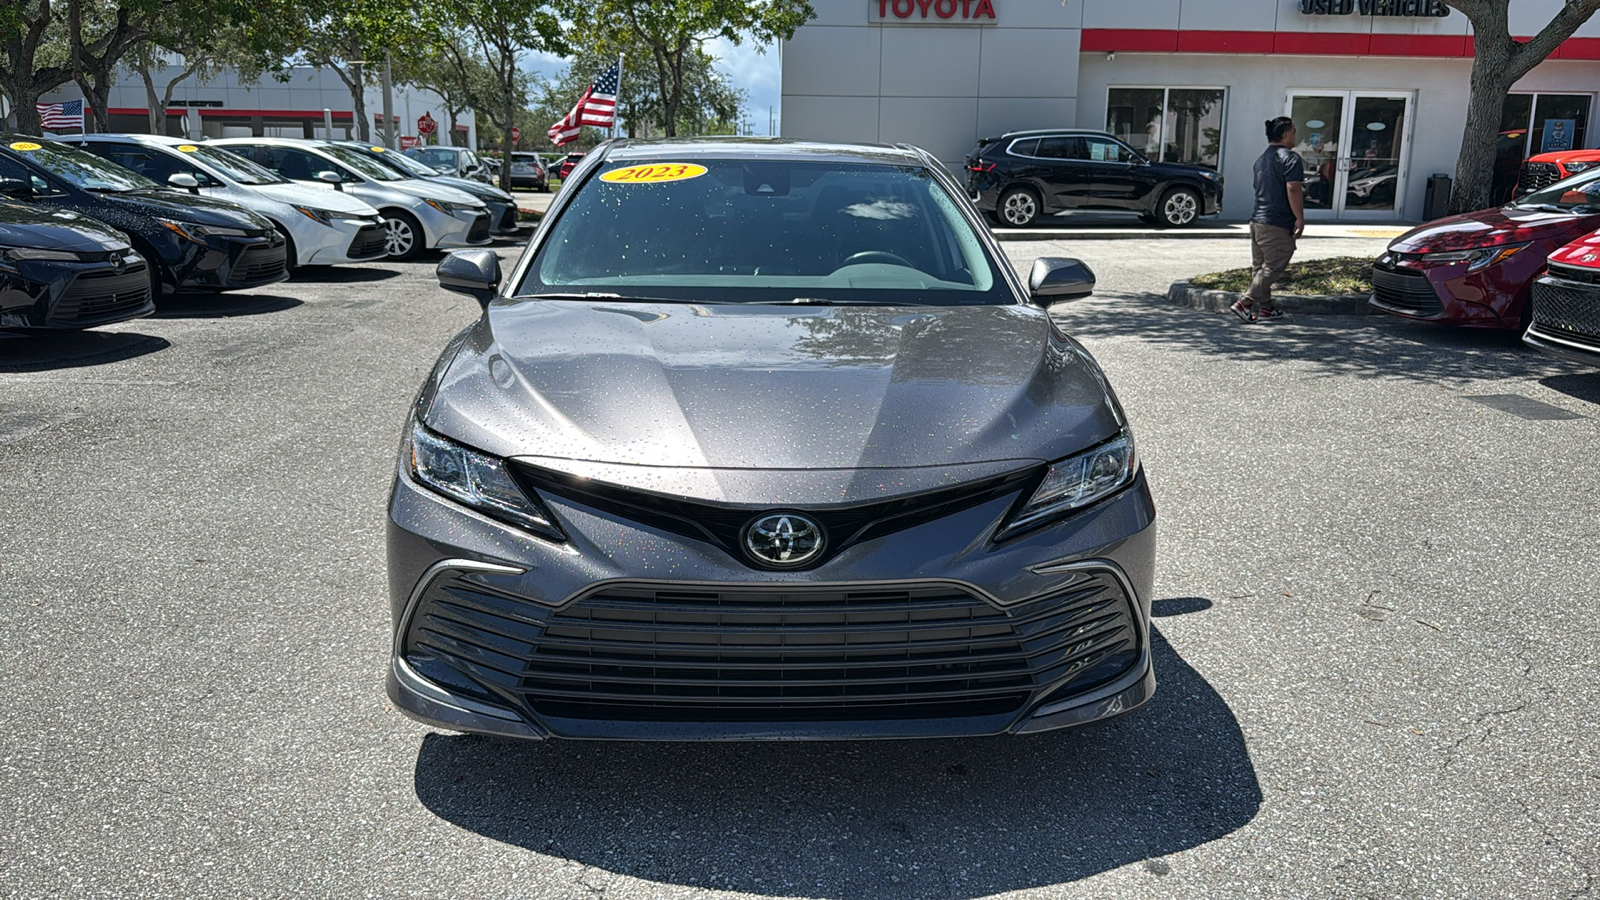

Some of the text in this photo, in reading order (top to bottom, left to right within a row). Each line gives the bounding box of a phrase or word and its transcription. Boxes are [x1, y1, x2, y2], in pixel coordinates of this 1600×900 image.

[873, 0, 996, 19] TOYOTA
[1301, 0, 1450, 17] USED VEHICLES
[615, 165, 688, 180] 2023
